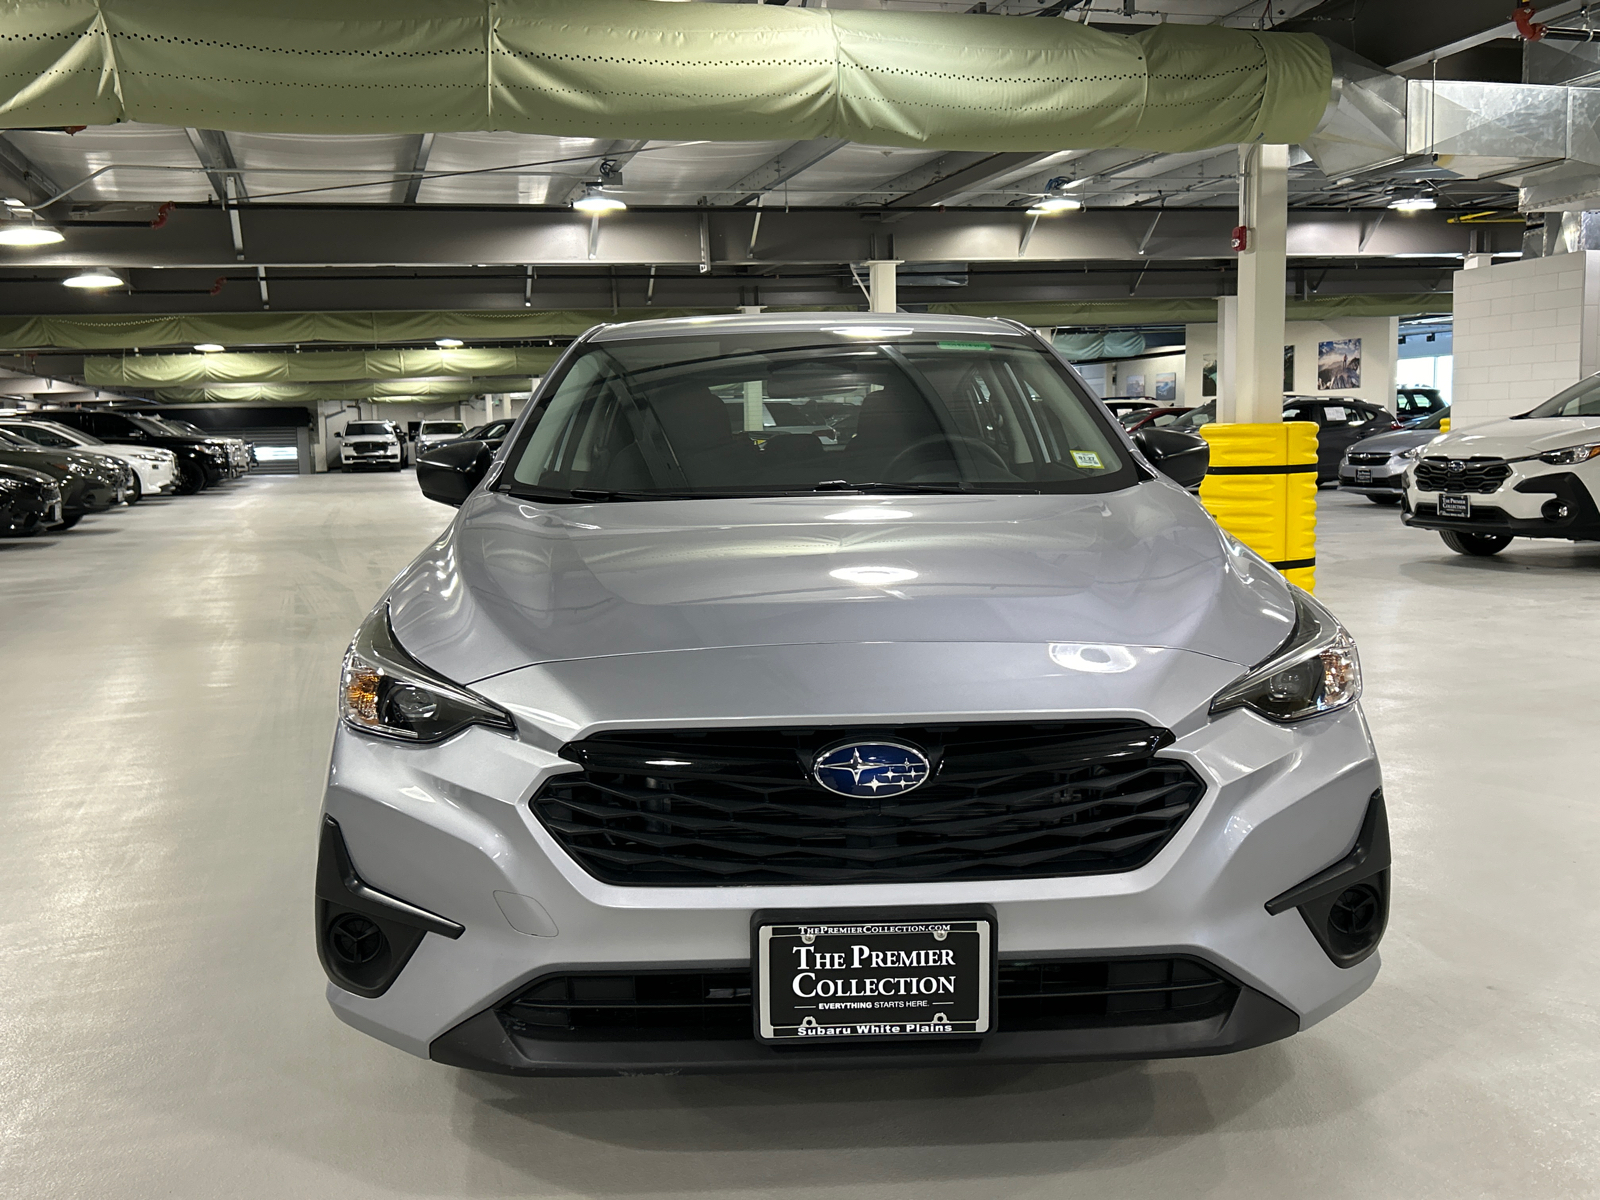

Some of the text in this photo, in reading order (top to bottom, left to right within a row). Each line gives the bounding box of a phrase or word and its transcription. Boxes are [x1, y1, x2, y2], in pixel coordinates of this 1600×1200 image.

[798, 924, 950, 935] THEPREMIERCOLLECTION.COM
[792, 945, 956, 970] THE PREMIER
[792, 972, 956, 998] COLLECTION
[818, 1000, 930, 1010] EVERYTHING STARTS HERE.
[797, 1023, 953, 1036] Subaru White Plains
